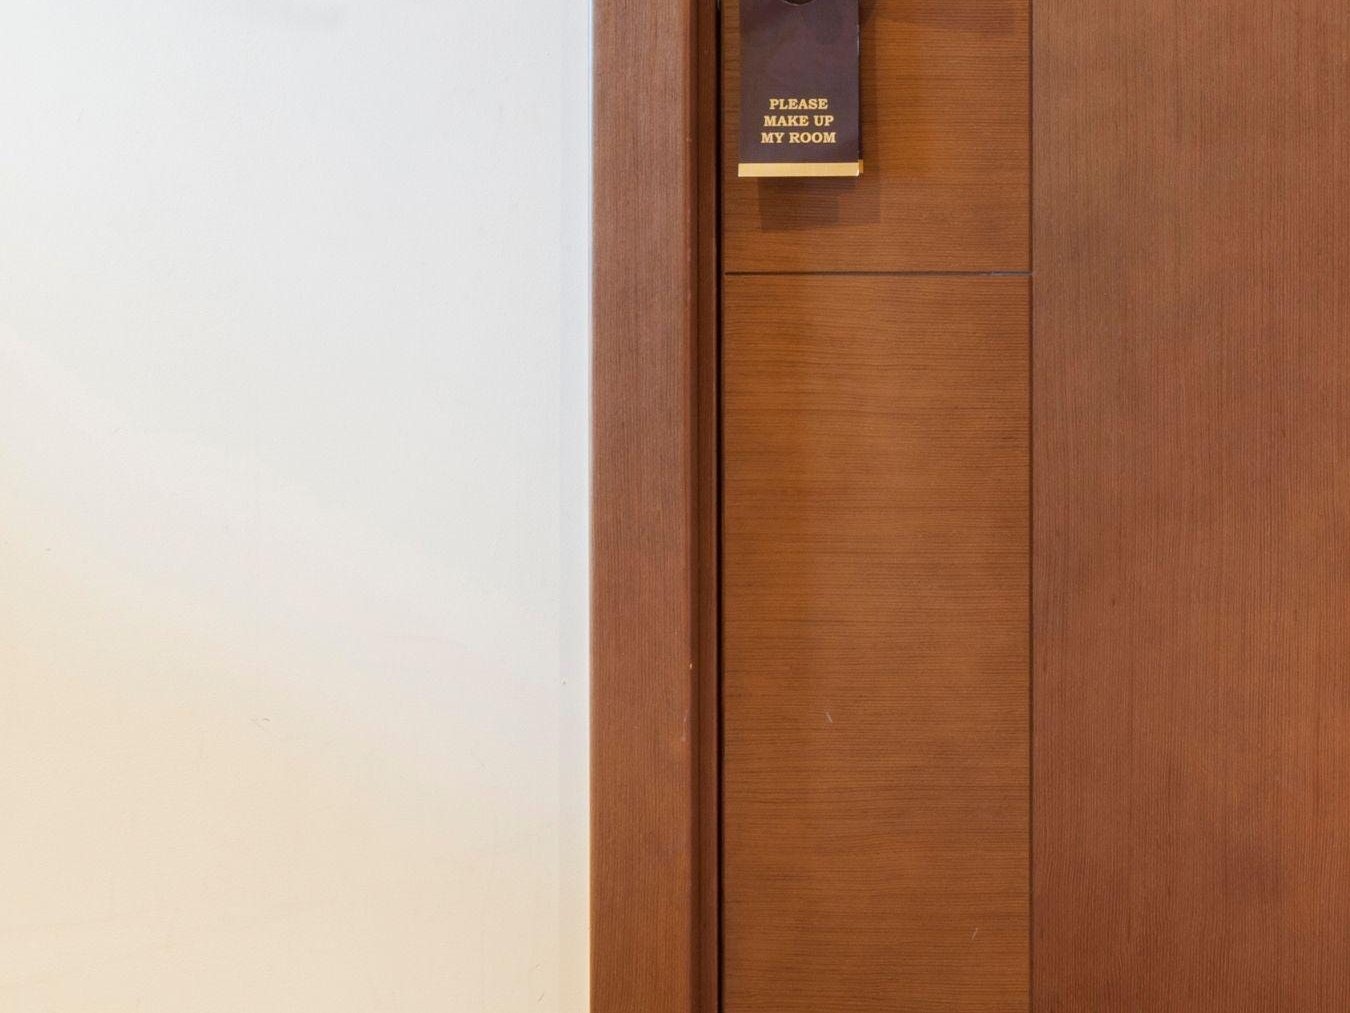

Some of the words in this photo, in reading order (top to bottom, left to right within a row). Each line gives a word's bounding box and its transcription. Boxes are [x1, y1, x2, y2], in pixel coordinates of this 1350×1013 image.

[768, 98, 829, 110] PLEASE
[763, 115, 810, 127] MAKE
[813, 115, 835, 127] UP
[760, 131, 785, 144] MY
[788, 131, 837, 144] ROOM
